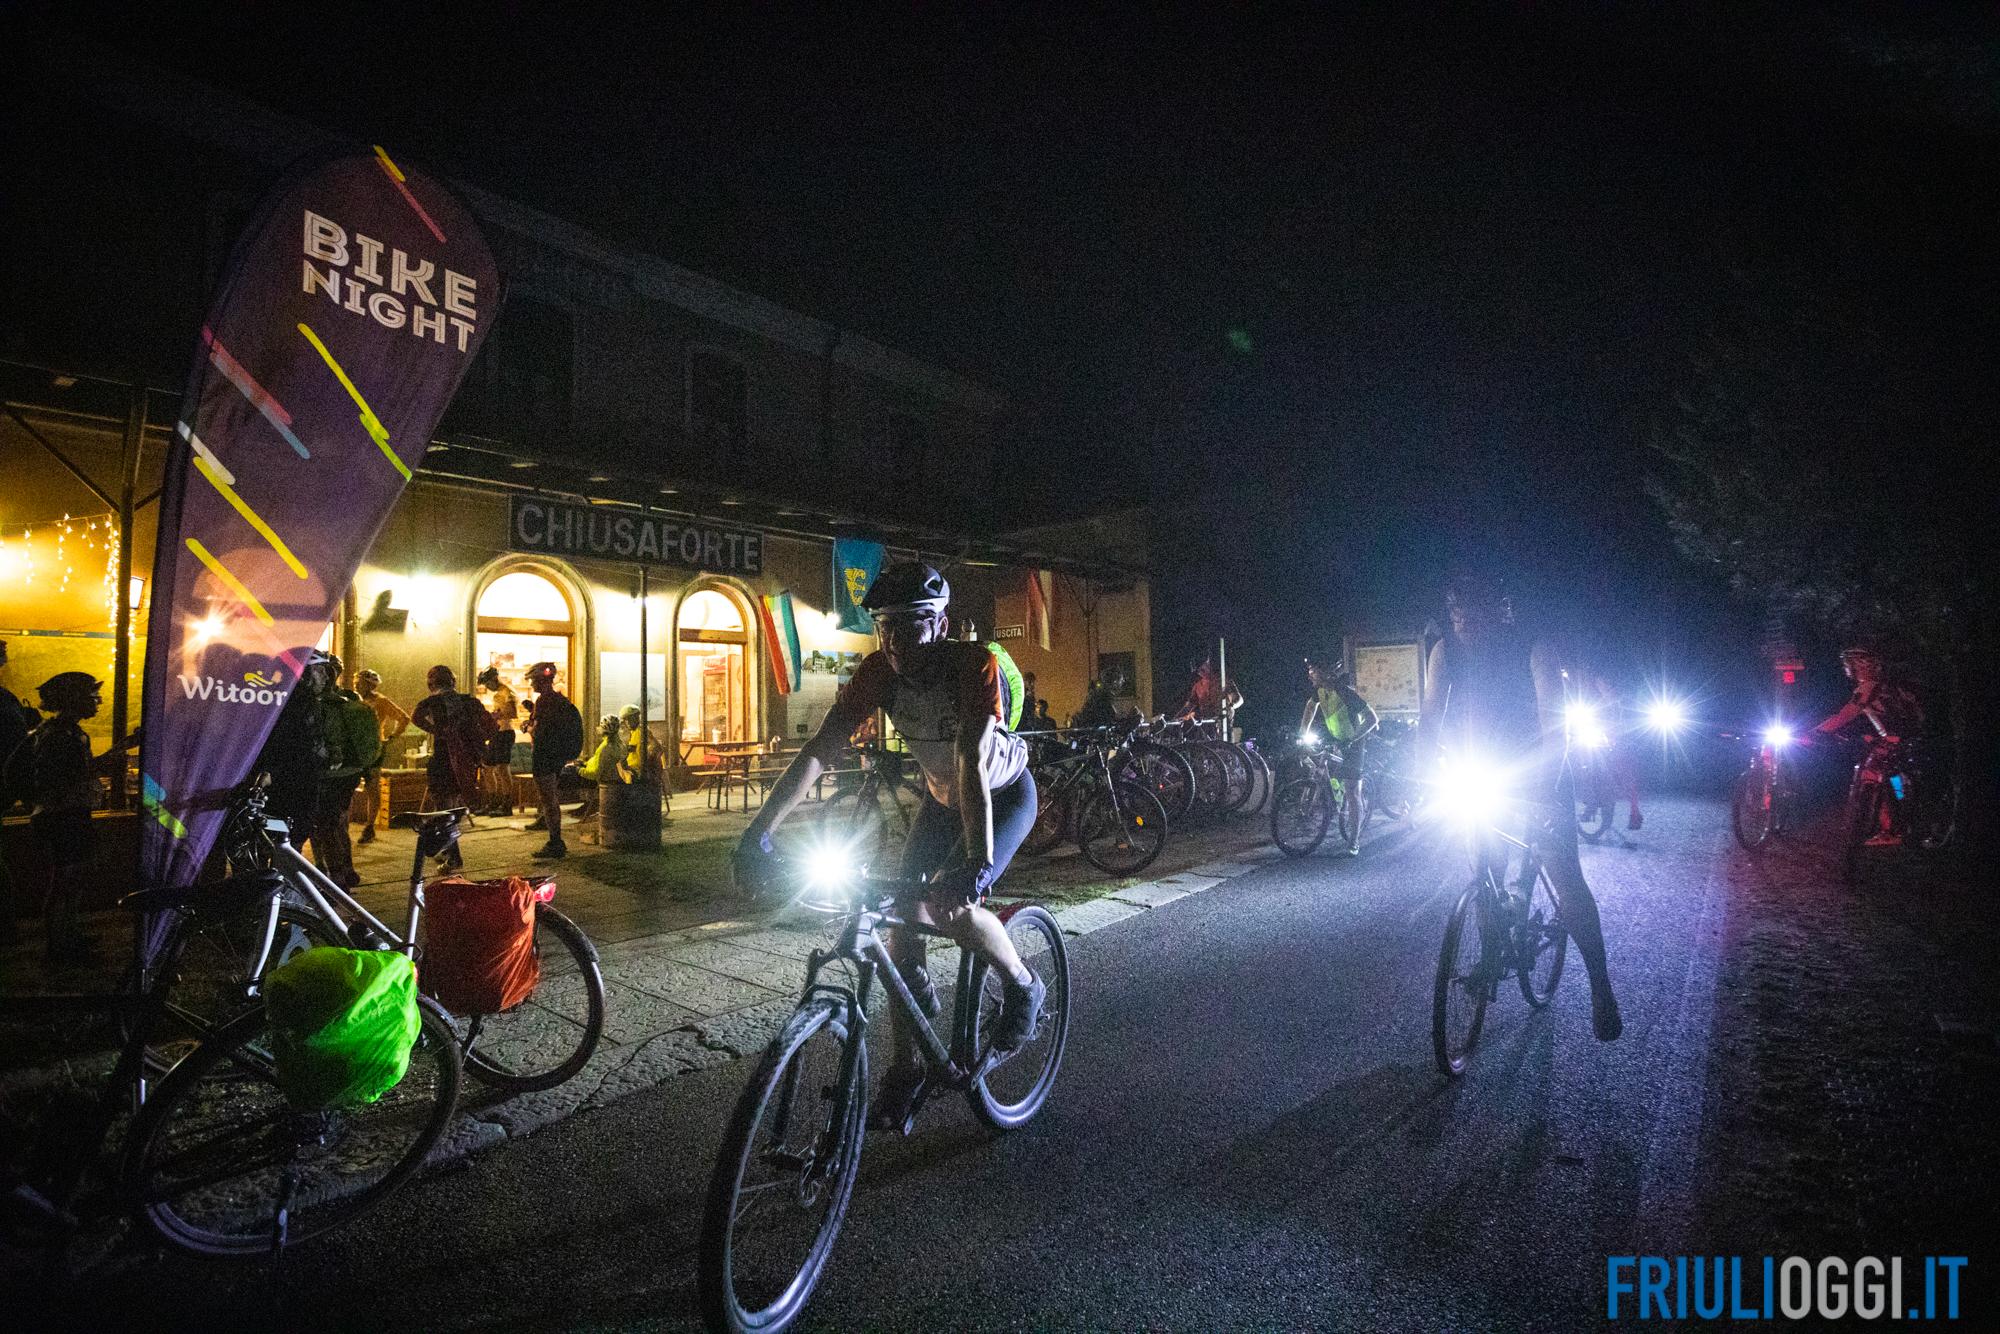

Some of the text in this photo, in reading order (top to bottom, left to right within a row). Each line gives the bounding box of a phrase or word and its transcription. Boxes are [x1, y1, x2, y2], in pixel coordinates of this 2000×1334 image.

[303, 209, 477, 321] BIKE
[303, 260, 475, 353] NIGHT
[517, 503, 758, 571] CHIUSAFORTE
[996, 627, 1022, 638] USCITA
[176, 674, 288, 706] Witoor
